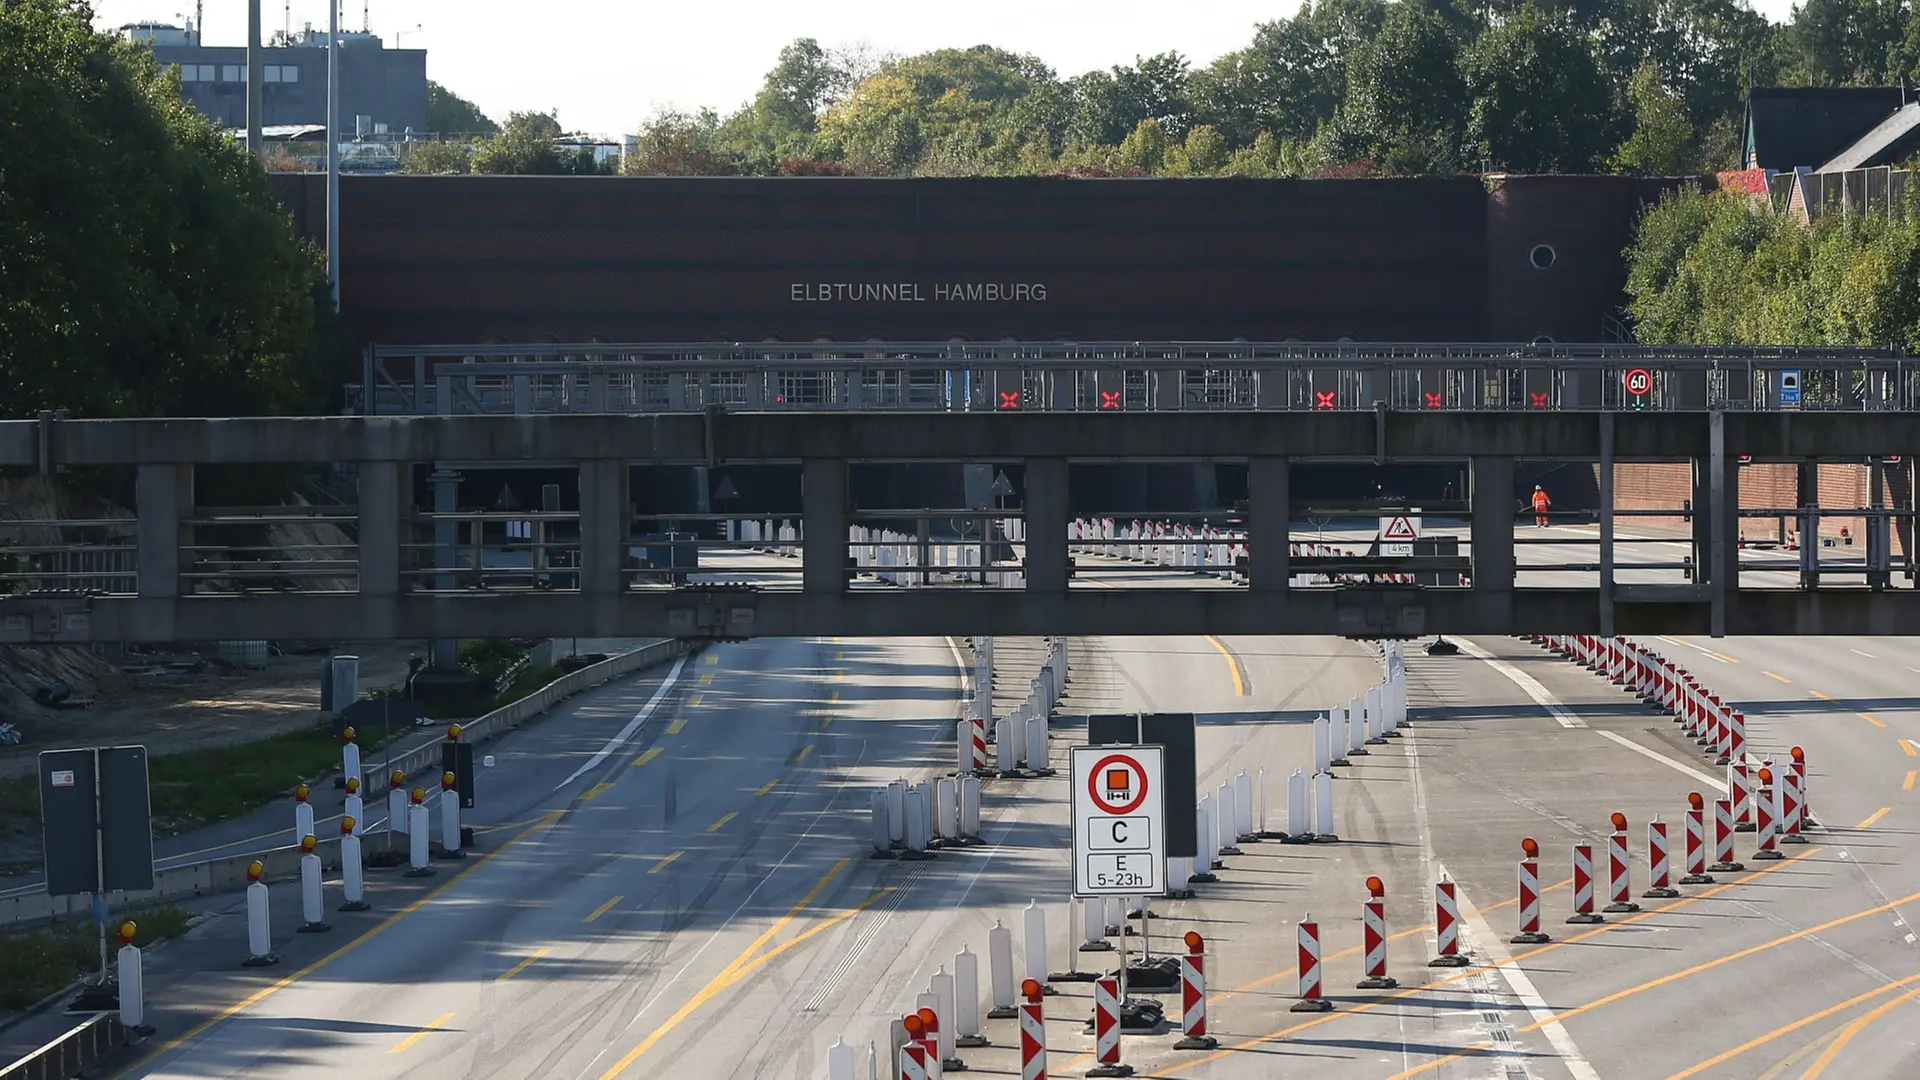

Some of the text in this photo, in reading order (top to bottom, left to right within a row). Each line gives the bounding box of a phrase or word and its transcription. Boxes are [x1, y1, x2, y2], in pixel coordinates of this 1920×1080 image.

[790, 283, 1048, 301] ELBTUNNEL HAMBURG
[1630, 375, 1646, 389] 60
[1391, 544, 1410, 552] 4 km
[1112, 820, 1128, 844] C
[1116, 855, 1127, 871] E
[1097, 873, 1143, 886] 5-23h
